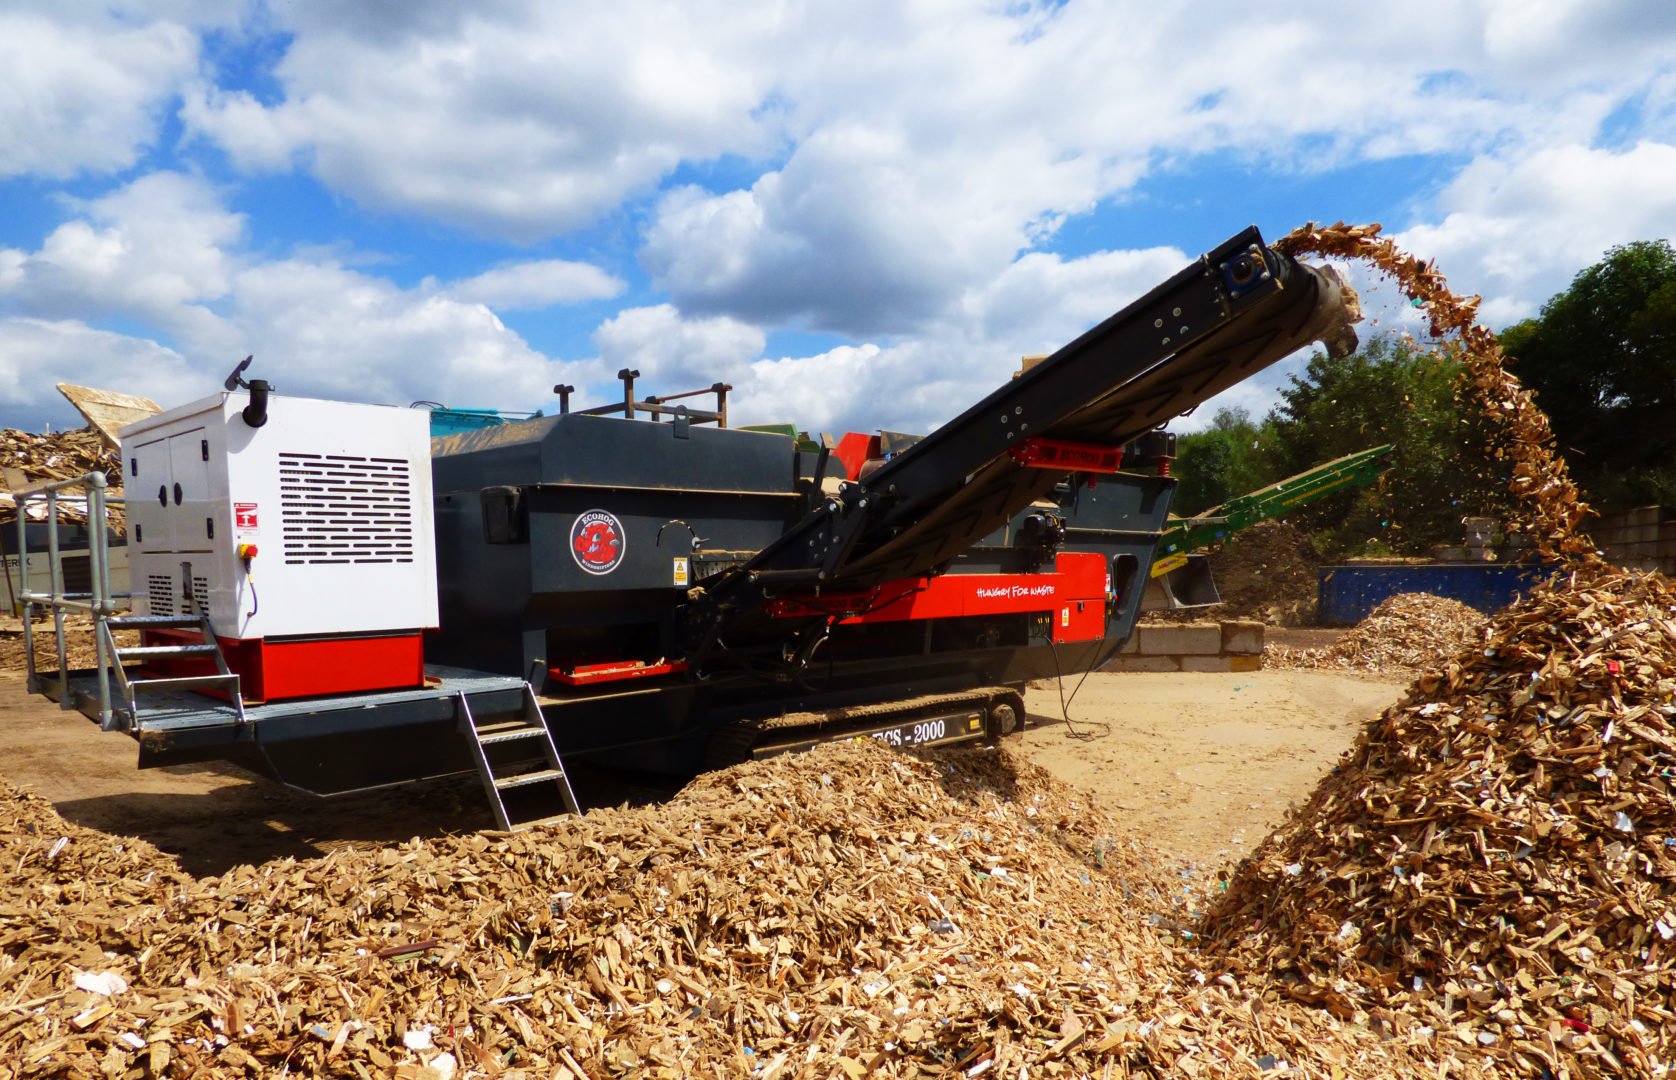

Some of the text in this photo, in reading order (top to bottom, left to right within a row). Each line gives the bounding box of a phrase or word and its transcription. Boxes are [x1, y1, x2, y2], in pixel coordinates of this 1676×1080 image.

[581, 513, 615, 527] ECOHOG
[976, 585, 1055, 599] HUNGRY FOR WASTE
[914, 719, 945, 744] 2000
